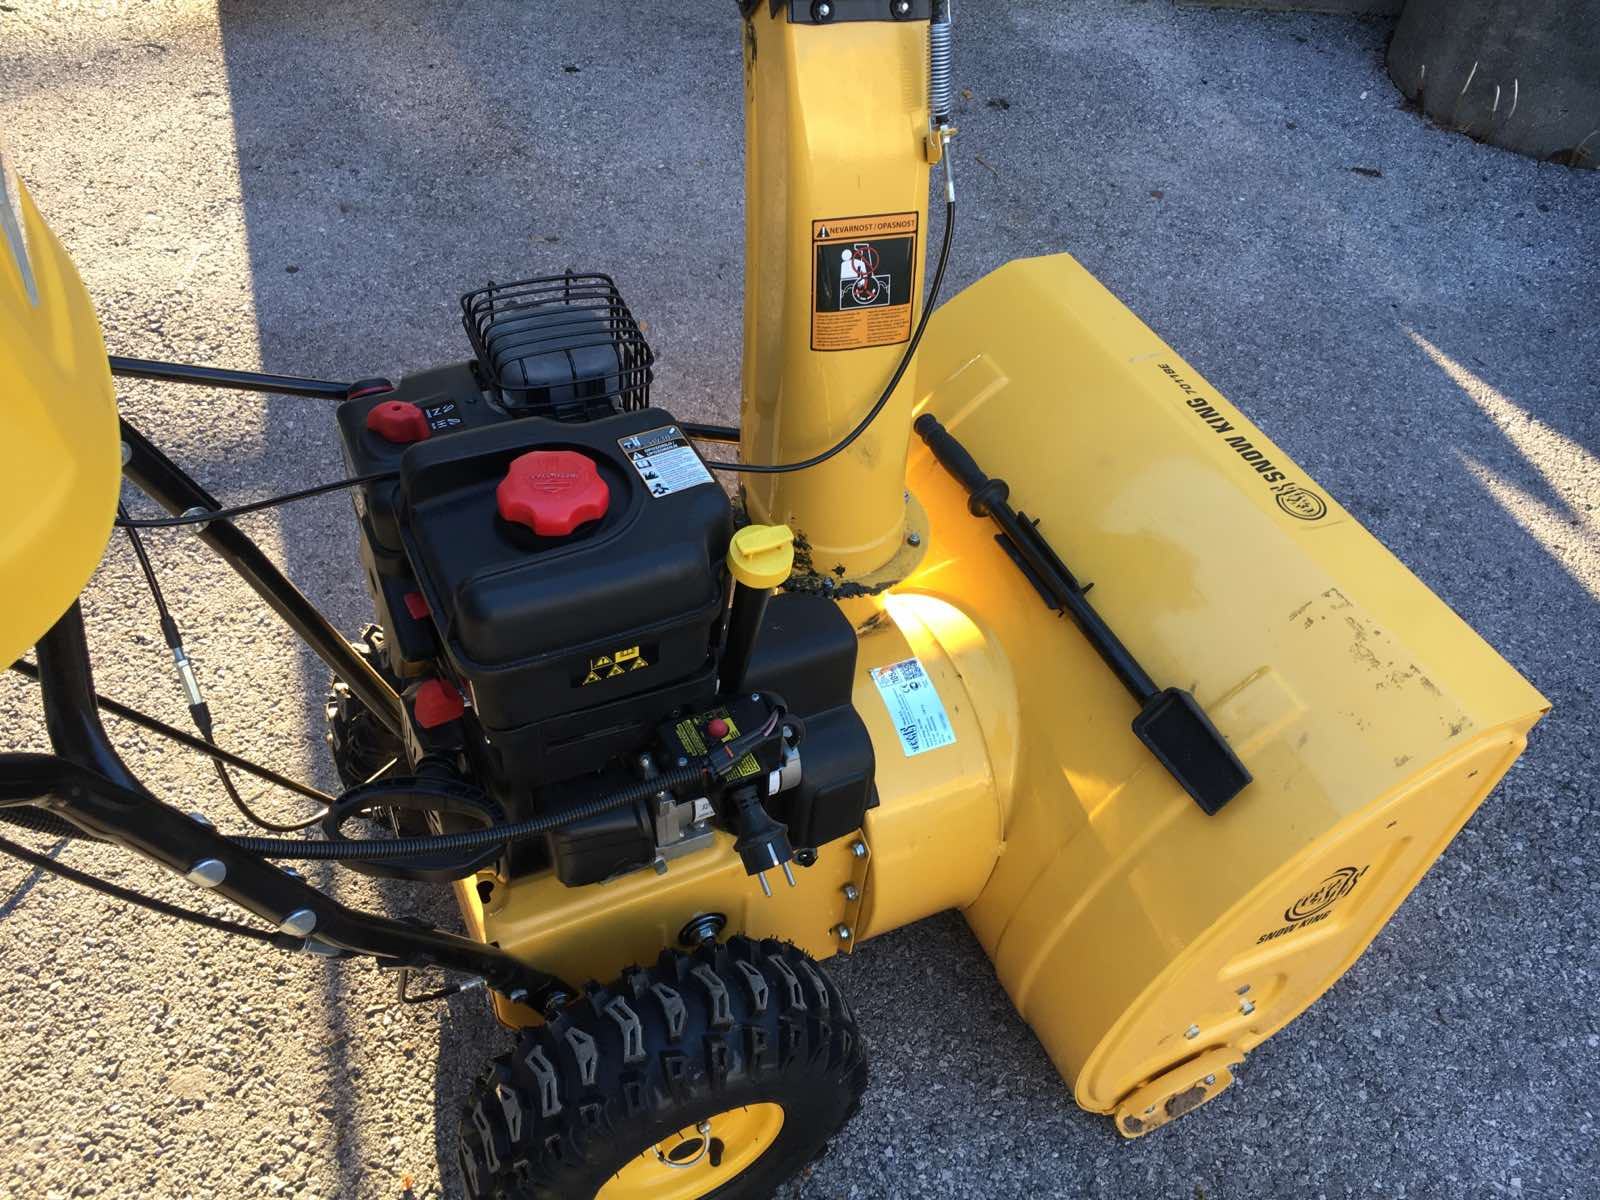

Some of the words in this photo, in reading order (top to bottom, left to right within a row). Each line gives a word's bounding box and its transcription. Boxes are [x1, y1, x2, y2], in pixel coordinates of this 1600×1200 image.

[829, 222, 873, 234] NEVARNOST
[877, 219, 915, 231] OPASNOST
[1186, 397, 1236, 434] KING
[1224, 435, 1286, 483] SNOW
[1256, 922, 1299, 945] SNOW
